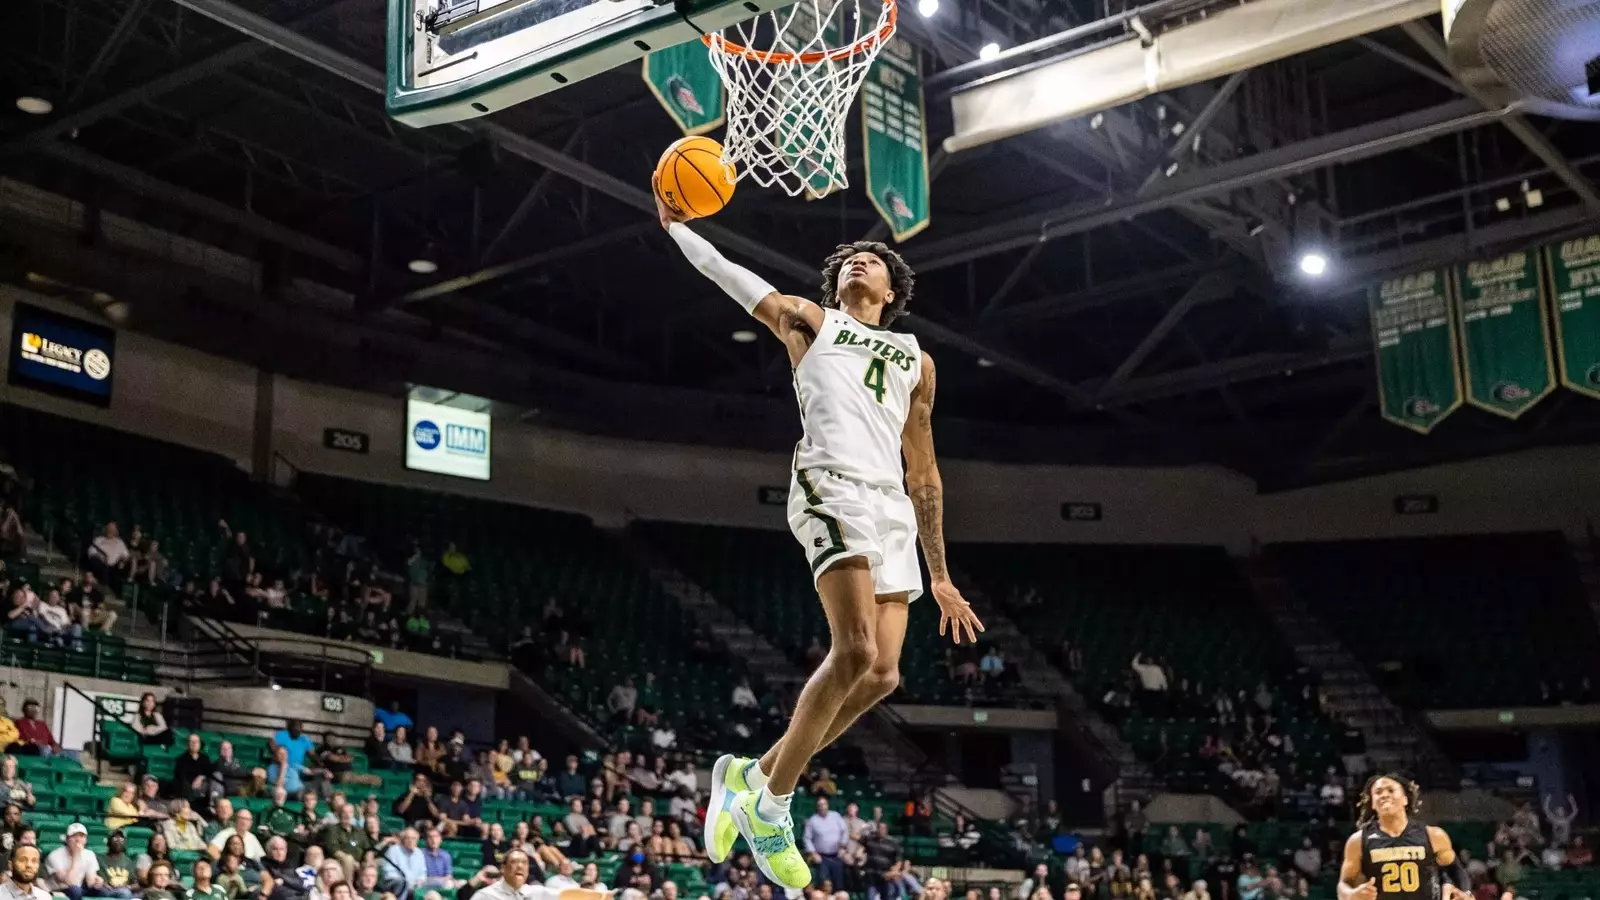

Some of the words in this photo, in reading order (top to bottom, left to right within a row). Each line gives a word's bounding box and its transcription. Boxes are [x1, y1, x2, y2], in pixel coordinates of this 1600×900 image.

[41, 338, 82, 362] LEGACY
[833, 329, 917, 372] BLAZERS
[863, 357, 887, 405] 4
[446, 423, 486, 454] IMM
[1380, 861, 1420, 893] 20
